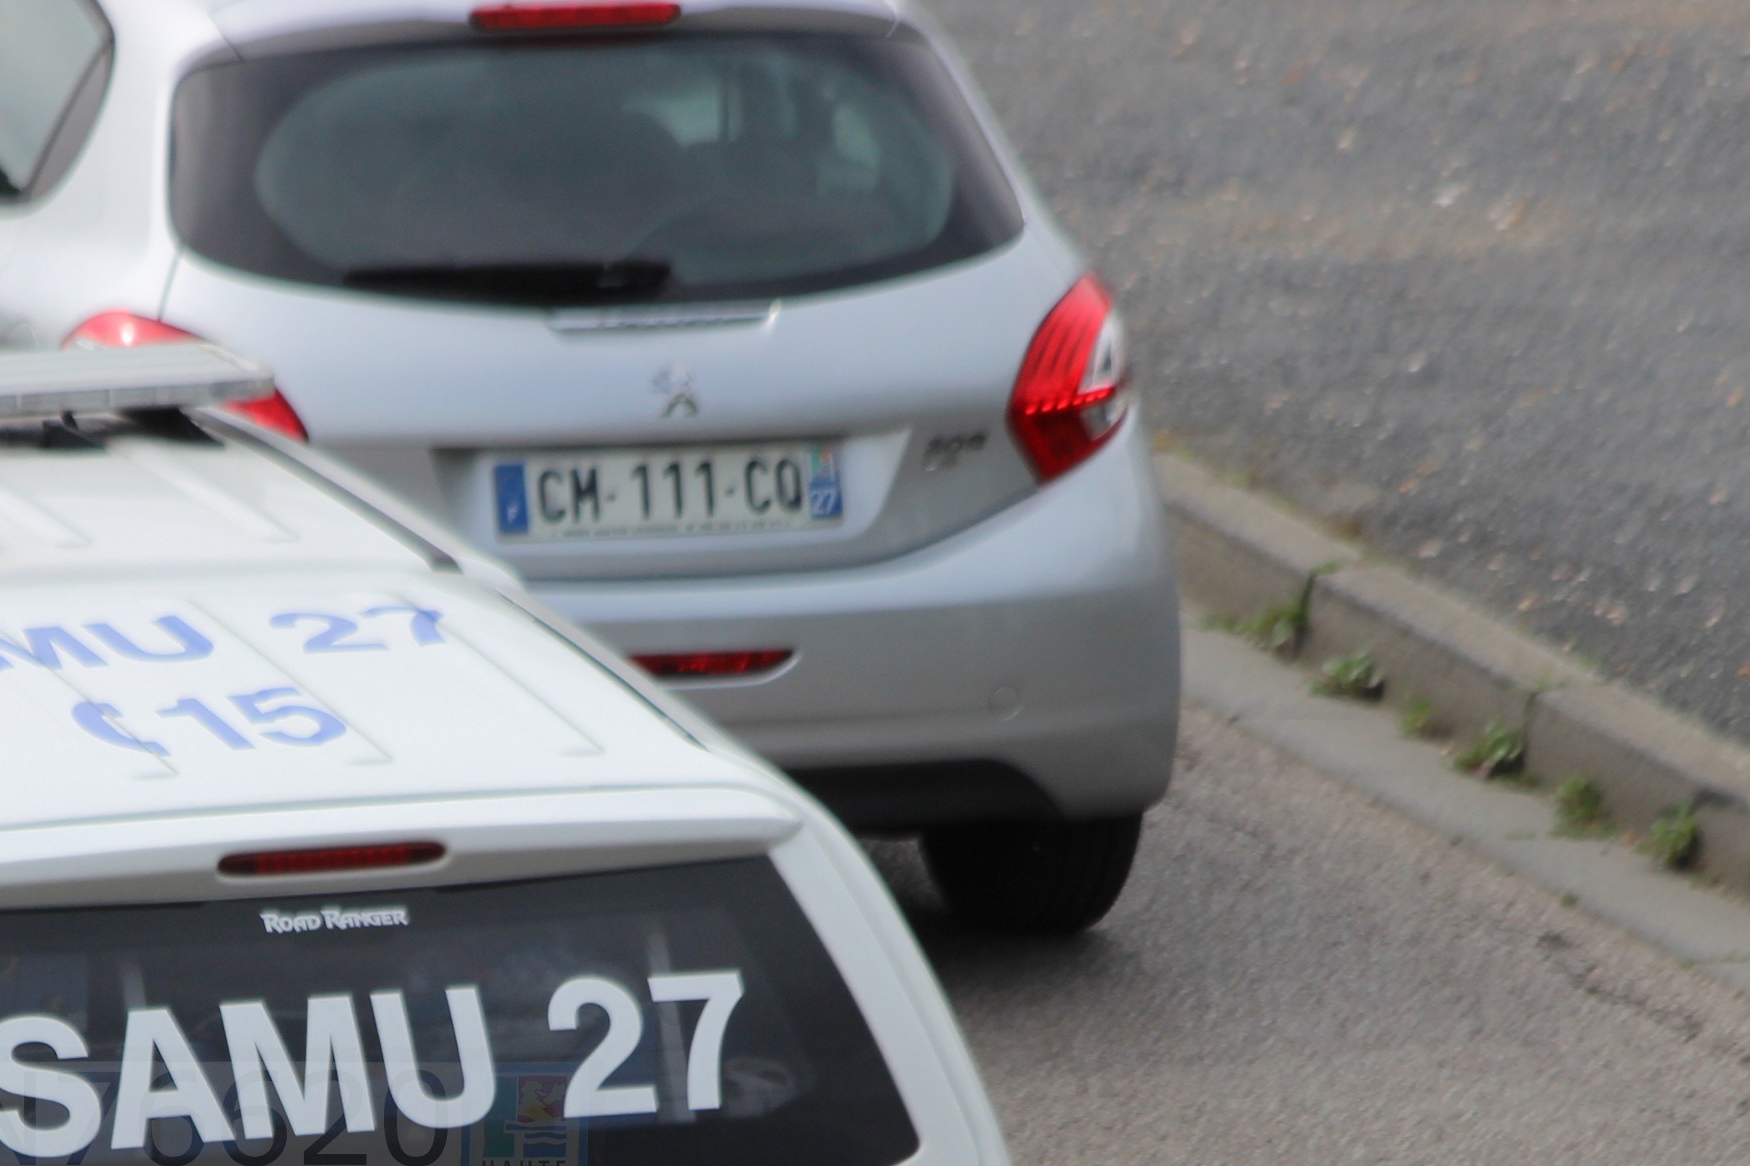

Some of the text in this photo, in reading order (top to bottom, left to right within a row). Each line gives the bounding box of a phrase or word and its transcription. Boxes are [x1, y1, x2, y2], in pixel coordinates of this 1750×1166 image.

[812, 488, 837, 516] 27
[268, 603, 447, 655] 27
[157, 686, 347, 751] 15
[259, 906, 409, 934] ROAD RANGER
[547, 970, 745, 1119] 27
